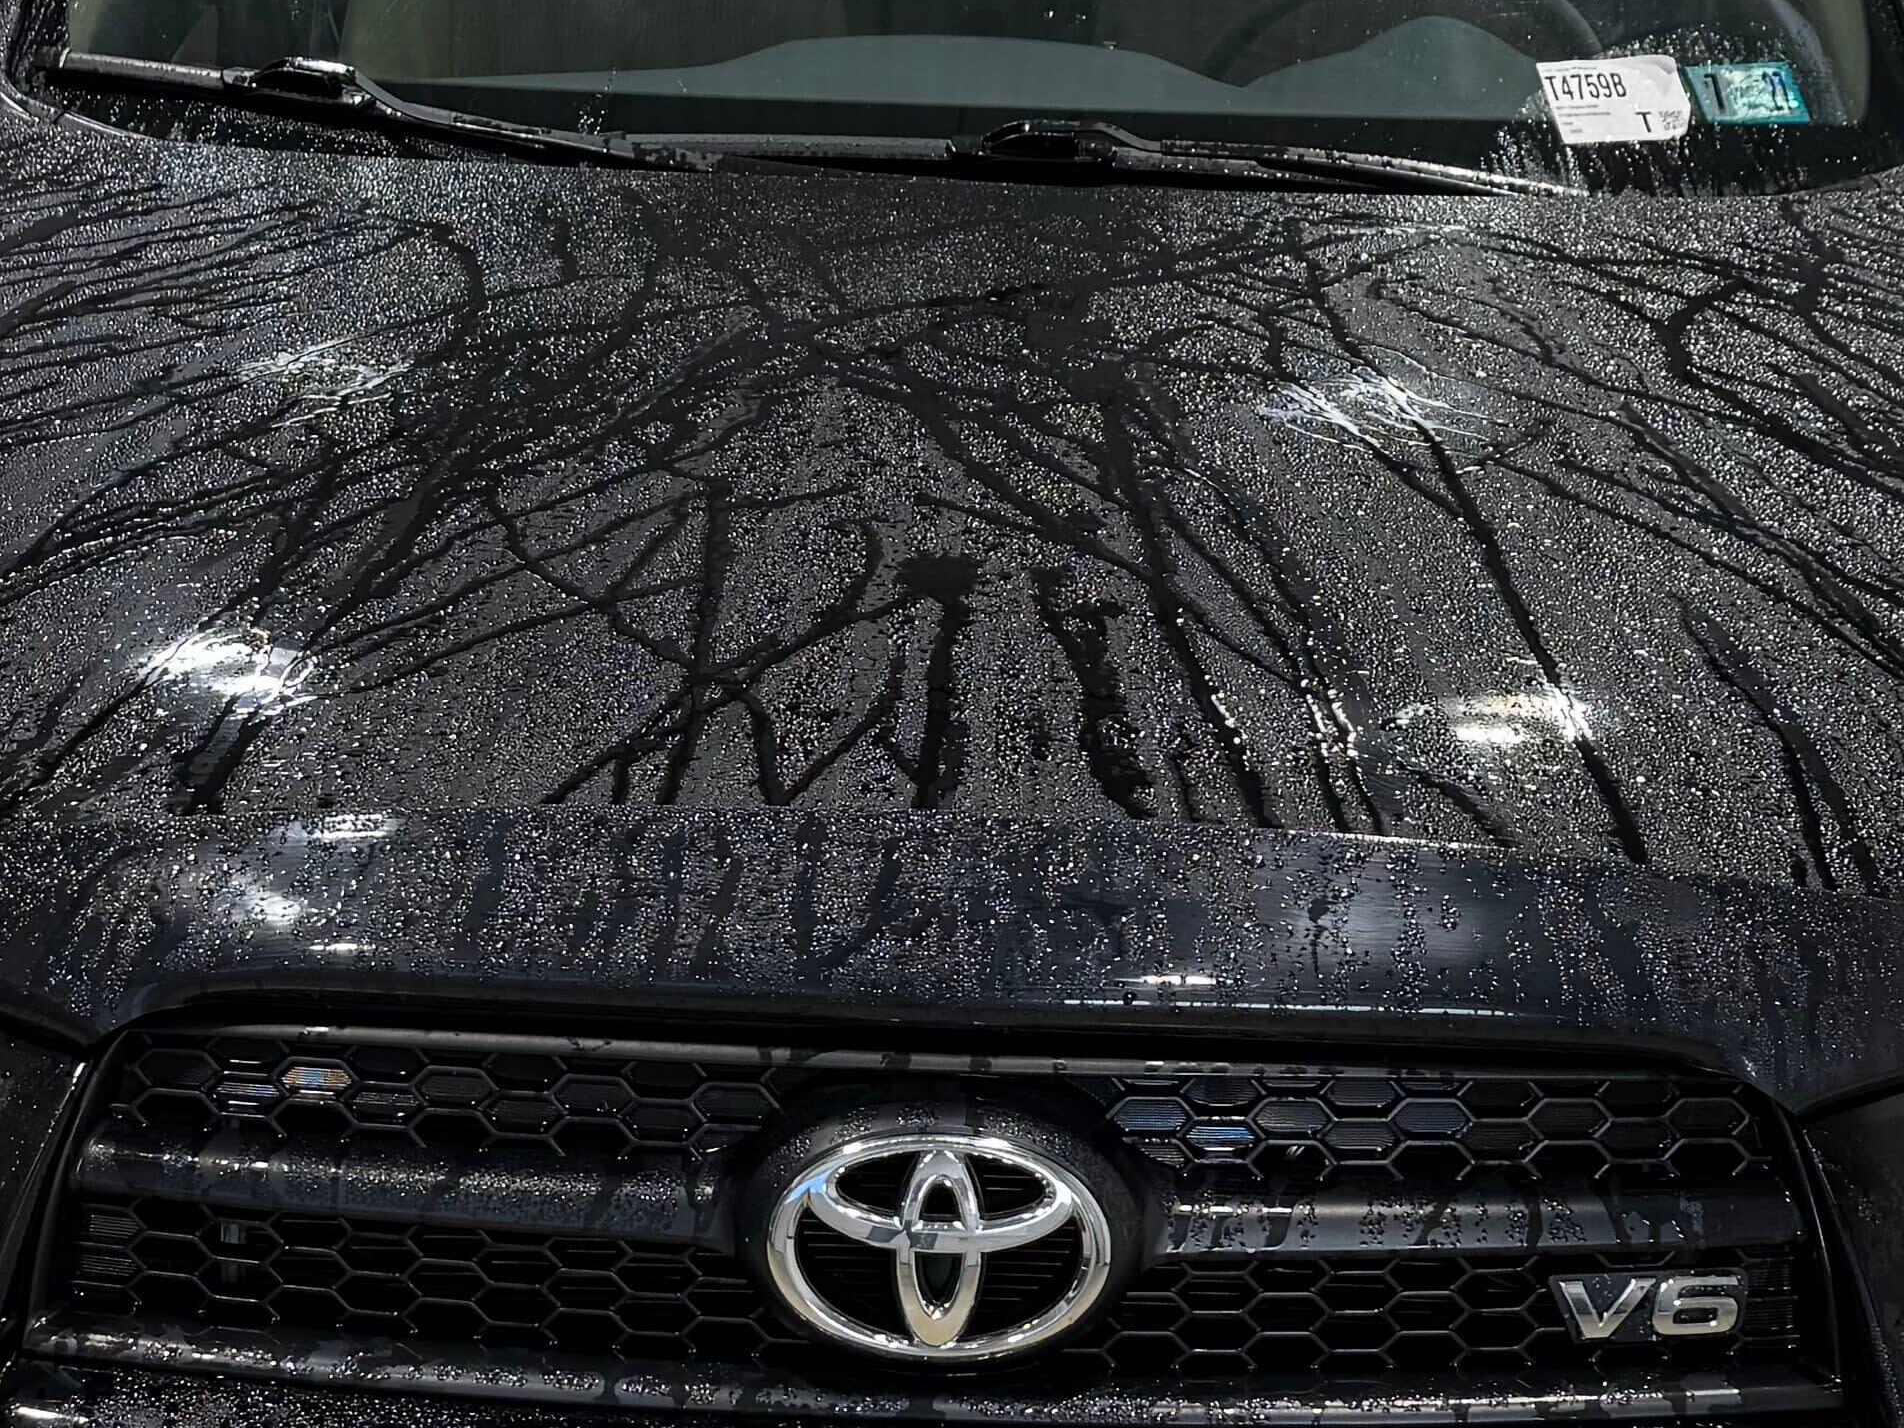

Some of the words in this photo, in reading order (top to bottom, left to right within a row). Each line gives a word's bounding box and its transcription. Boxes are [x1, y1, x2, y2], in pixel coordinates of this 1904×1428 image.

[1544, 71, 1628, 102] T4759B
[1635, 111, 1652, 133] T
[1558, 1276, 1739, 1339] V6
